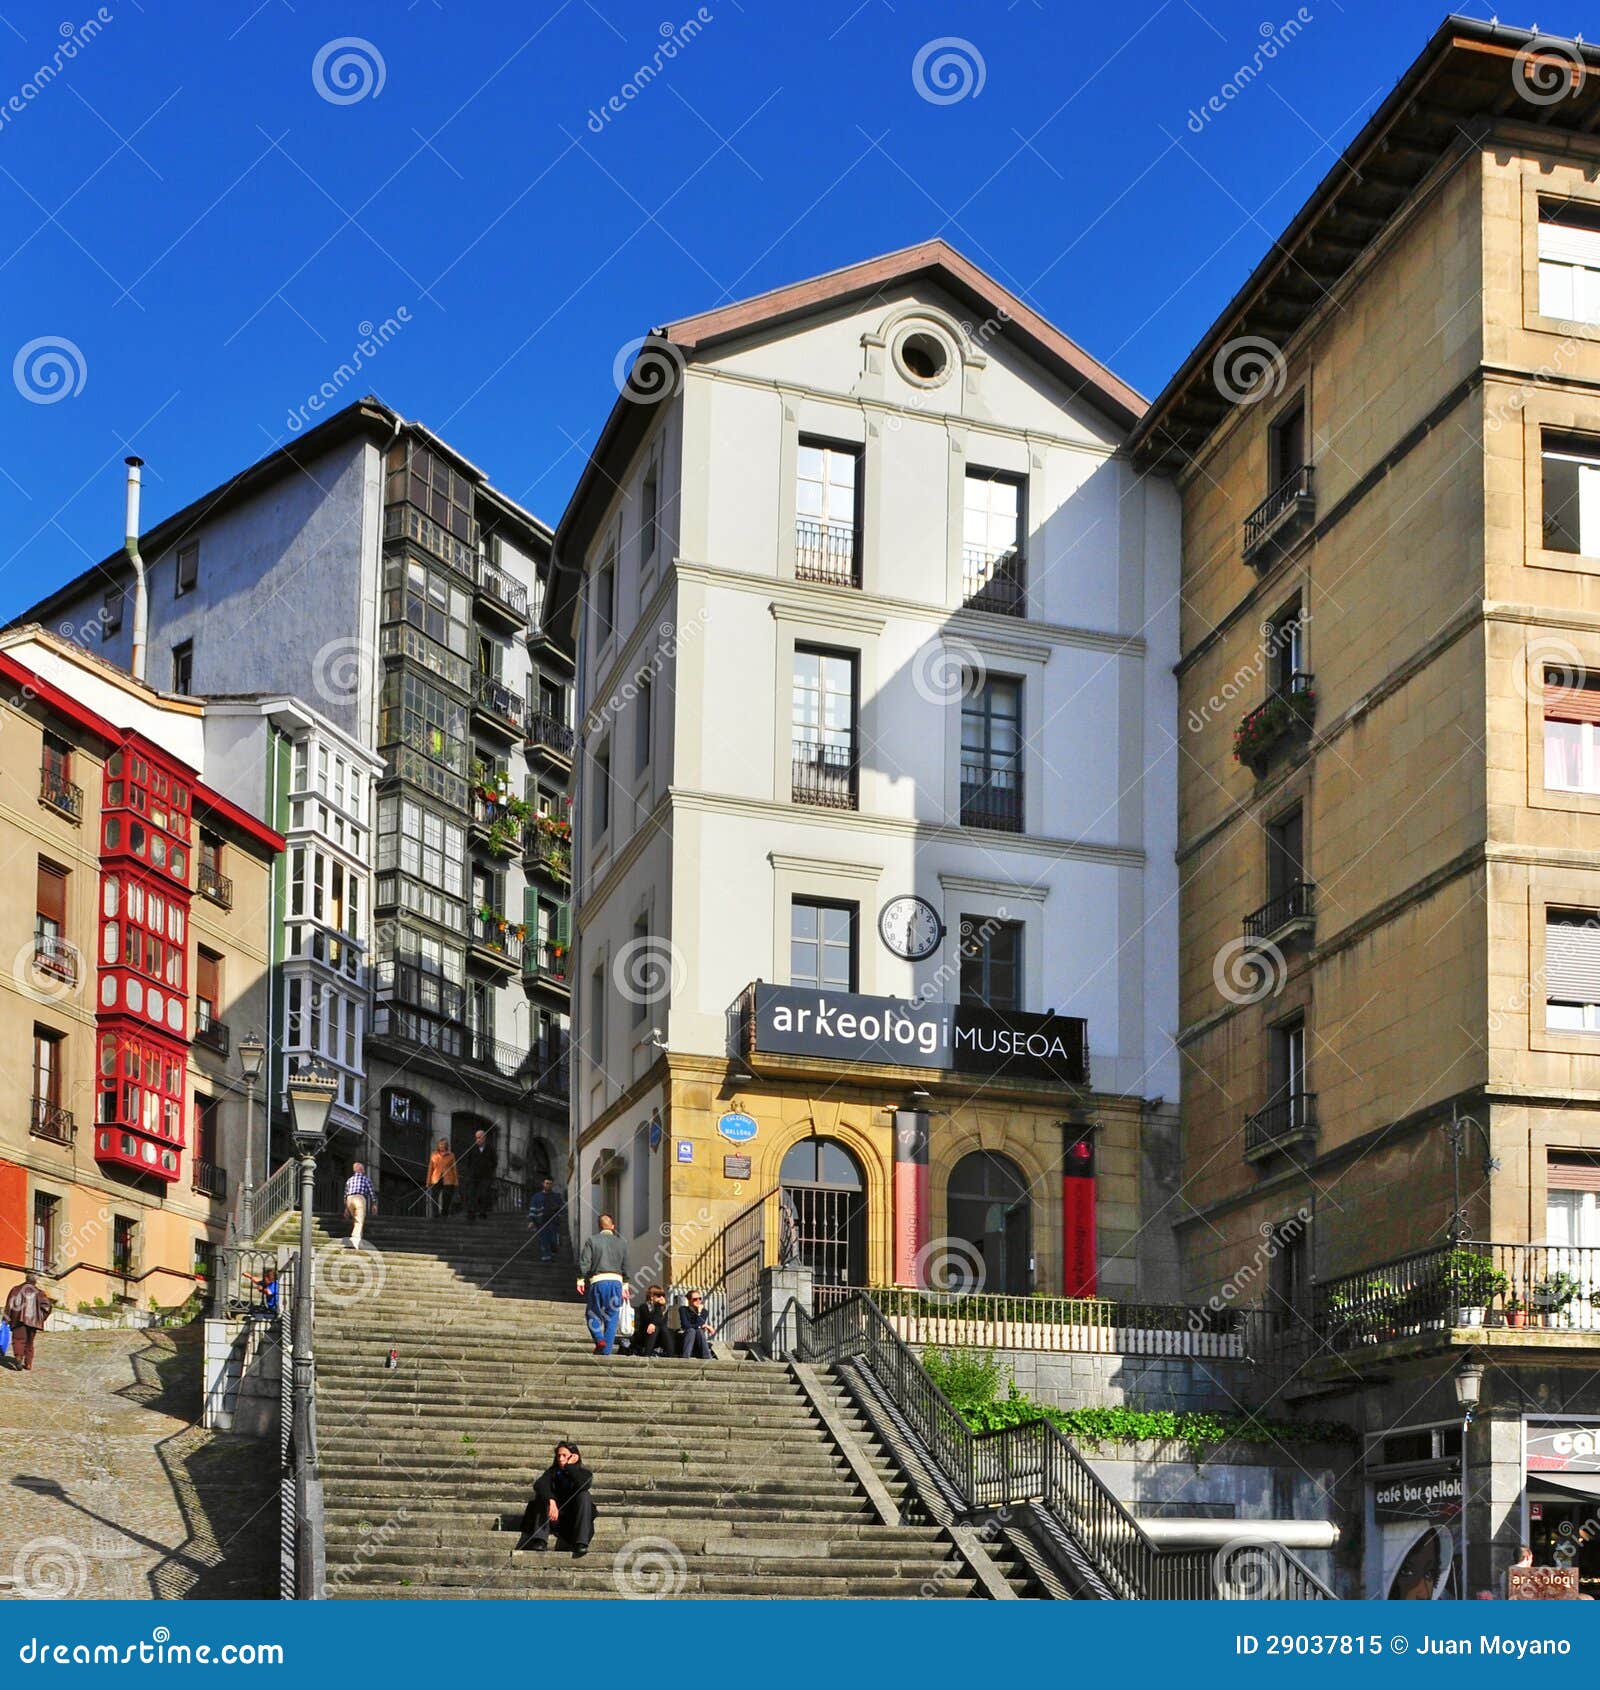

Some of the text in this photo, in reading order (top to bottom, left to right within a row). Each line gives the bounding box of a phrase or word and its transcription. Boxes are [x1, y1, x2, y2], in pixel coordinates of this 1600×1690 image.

[773, 999, 1068, 1059] arkeologi MUSEOA
[734, 1182, 742, 1196] 2
[1403, 1484, 1421, 1501] bar
